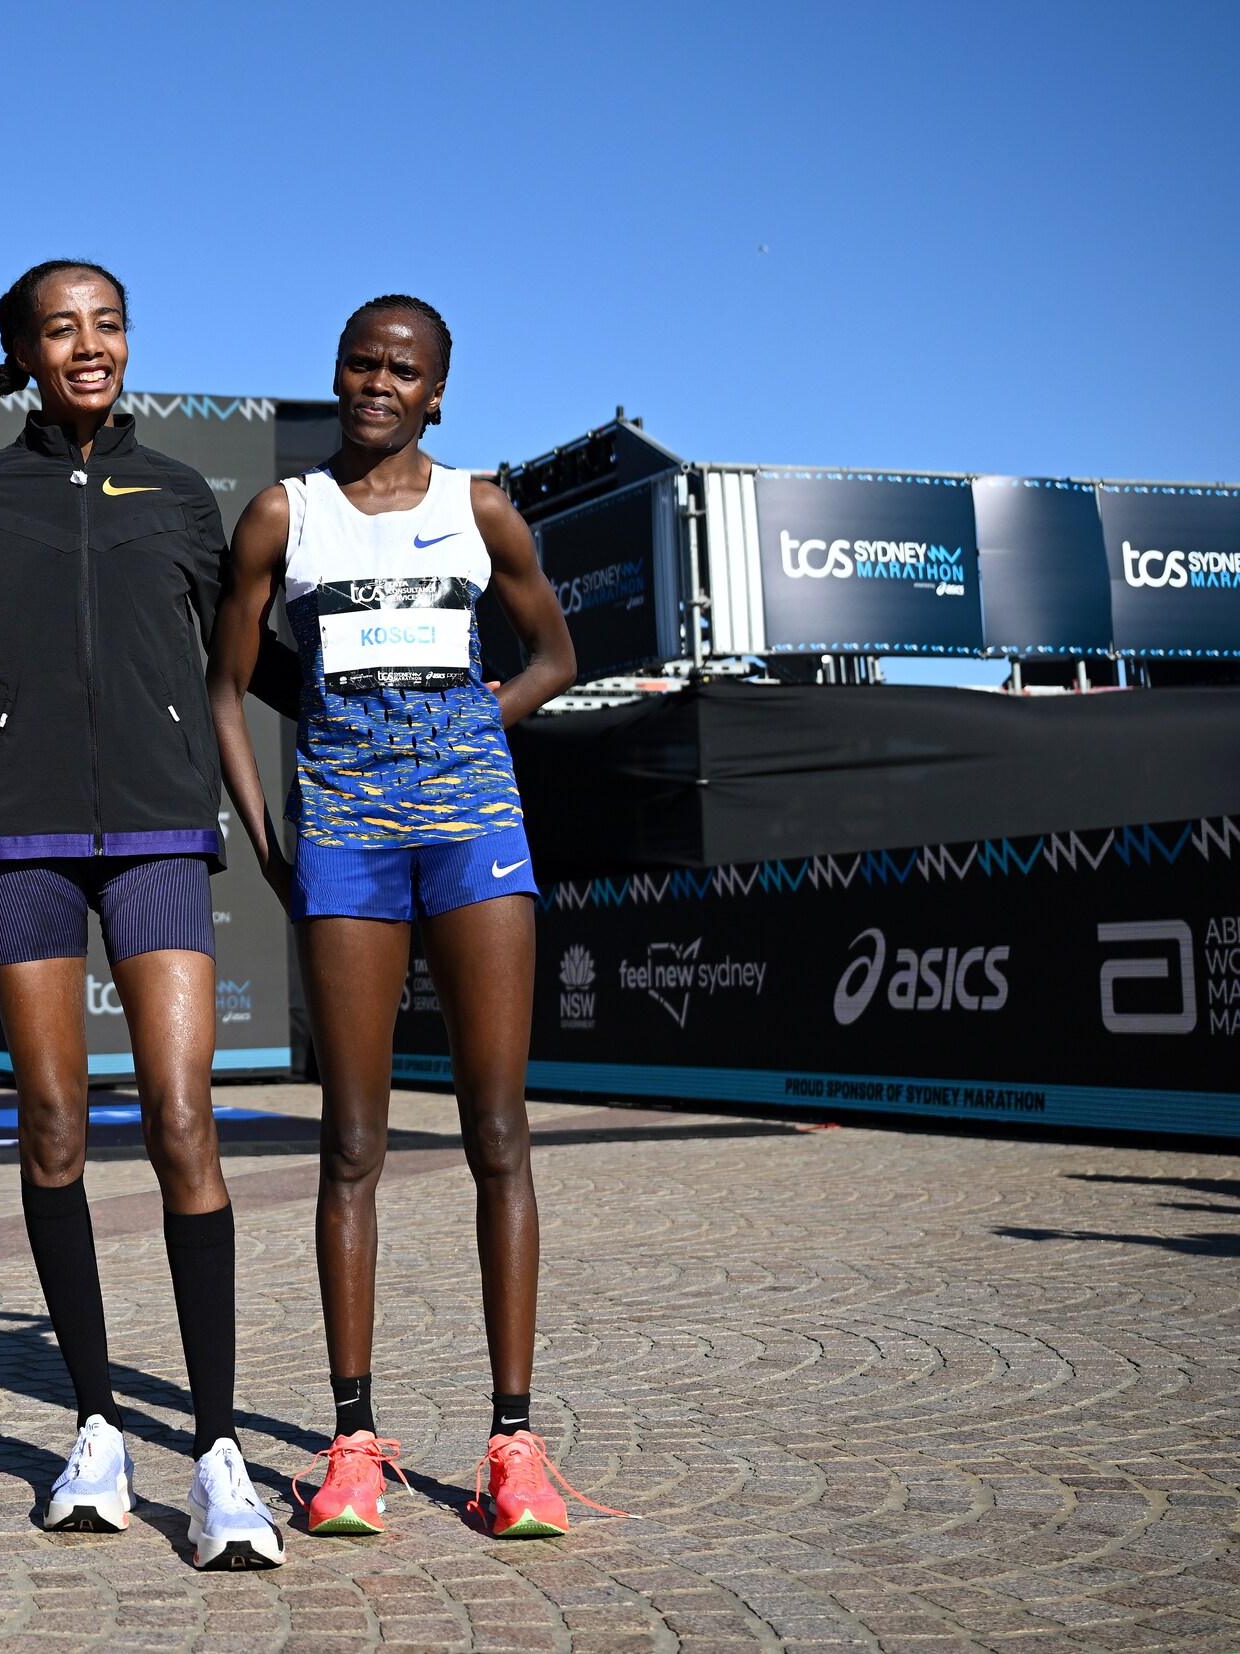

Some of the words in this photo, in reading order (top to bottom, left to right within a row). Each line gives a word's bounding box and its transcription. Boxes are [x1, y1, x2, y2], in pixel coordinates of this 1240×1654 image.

[780, 530, 854, 579] tcs
[854, 540, 927, 564] SYDNEY
[1122, 540, 1188, 588] tcs
[582, 563, 621, 593] SYDNEY
[856, 561, 965, 583] MARATHON
[360, 626, 436, 647] KOSGEI
[1205, 916, 1240, 945] AB
[619, 955, 652, 988] feel
[655, 964, 694, 987] new
[698, 955, 767, 995] sydney
[887, 945, 1010, 1011] asics
[560, 992, 595, 1018] NSW
[785, 1078, 824, 1097] PROUD
[826, 1080, 884, 1101] SPONSOR
[886, 1083, 902, 1102] OF
[906, 1084, 959, 1107] SYDNEY
[963, 1088, 1046, 1112] MARATHON
